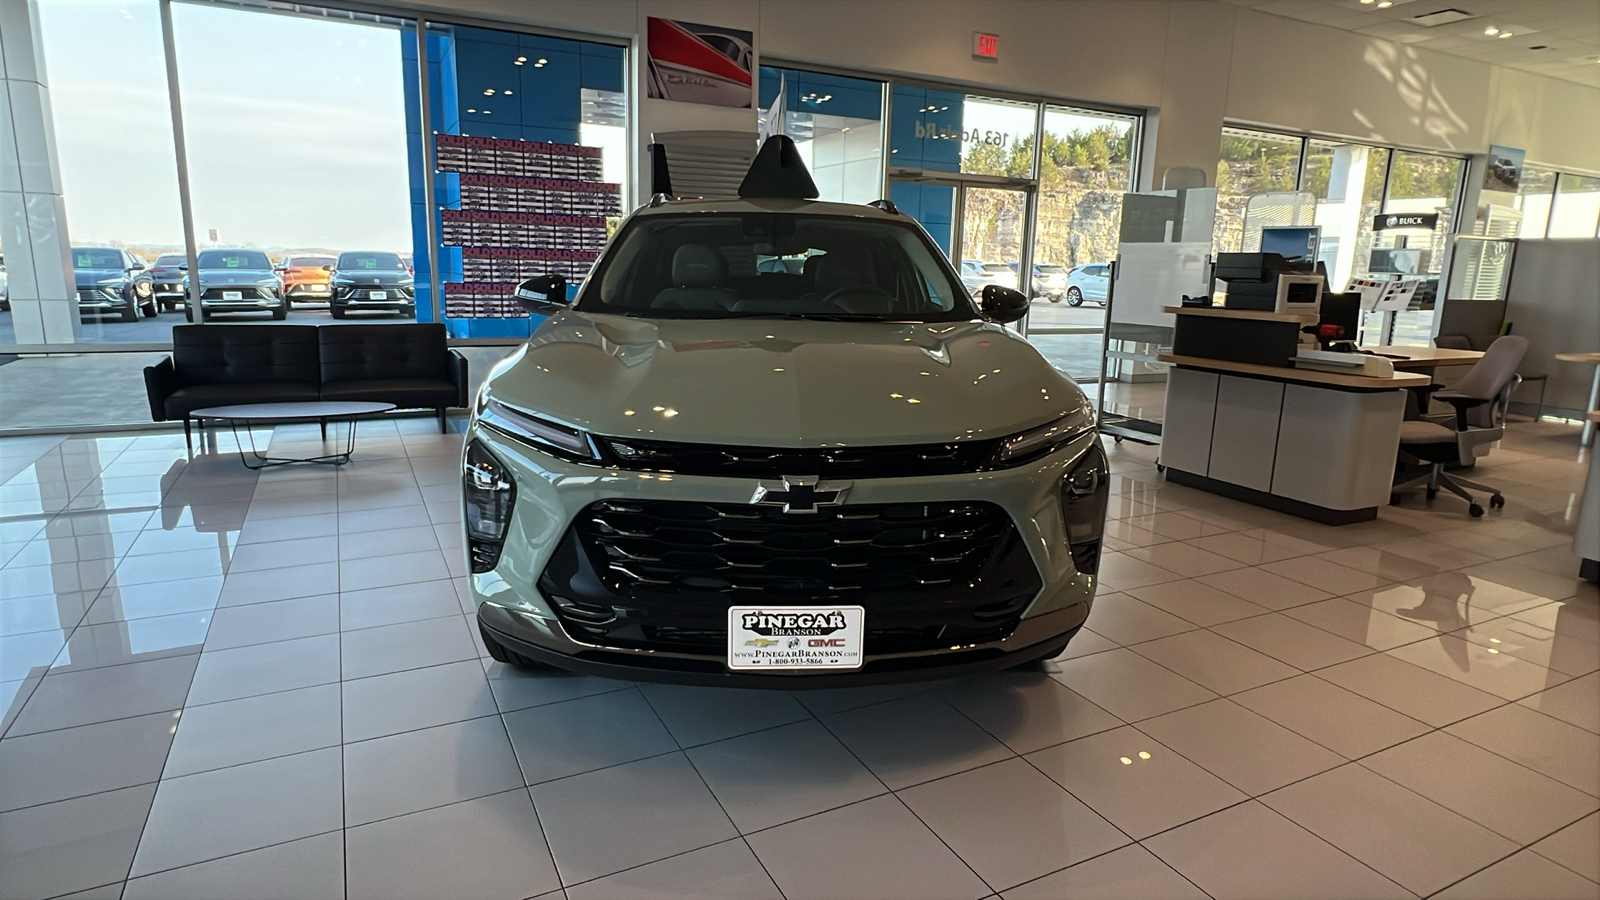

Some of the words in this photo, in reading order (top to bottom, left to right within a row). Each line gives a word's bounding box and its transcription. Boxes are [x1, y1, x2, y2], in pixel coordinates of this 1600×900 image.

[979, 35, 998, 55] EXIT
[436, 135, 465, 146] SOLD
[466, 137, 494, 147] SOLD
[496, 138, 523, 149] SOLD
[524, 141, 549, 152] SOLD
[552, 143, 576, 154] SOLD
[461, 173, 488, 184] SOLD
[489, 175, 516, 186] SOLD
[517, 176, 544, 187] SOLD
[545, 179, 571, 189] SOLD
[443, 210, 470, 220] SOLD
[472, 211, 499, 221] SOLD
[501, 212, 527, 222] SOLD
[528, 213, 553, 223] SOLD
[555, 215, 580, 224] SOLD
[1399, 216, 1423, 225] BUICK
[463, 247, 490, 257] SOLD
[491, 248, 518, 258] SOLD
[519, 249, 545, 258] SOLD
[547, 250, 570, 259] SOLD
[446, 283, 473, 293] SOLD
[474, 283, 501, 293] SOLD
[743, 614, 846, 629] PINEGAR
[771, 627, 821, 636] BRANSON
[807, 639, 846, 648] GMC
